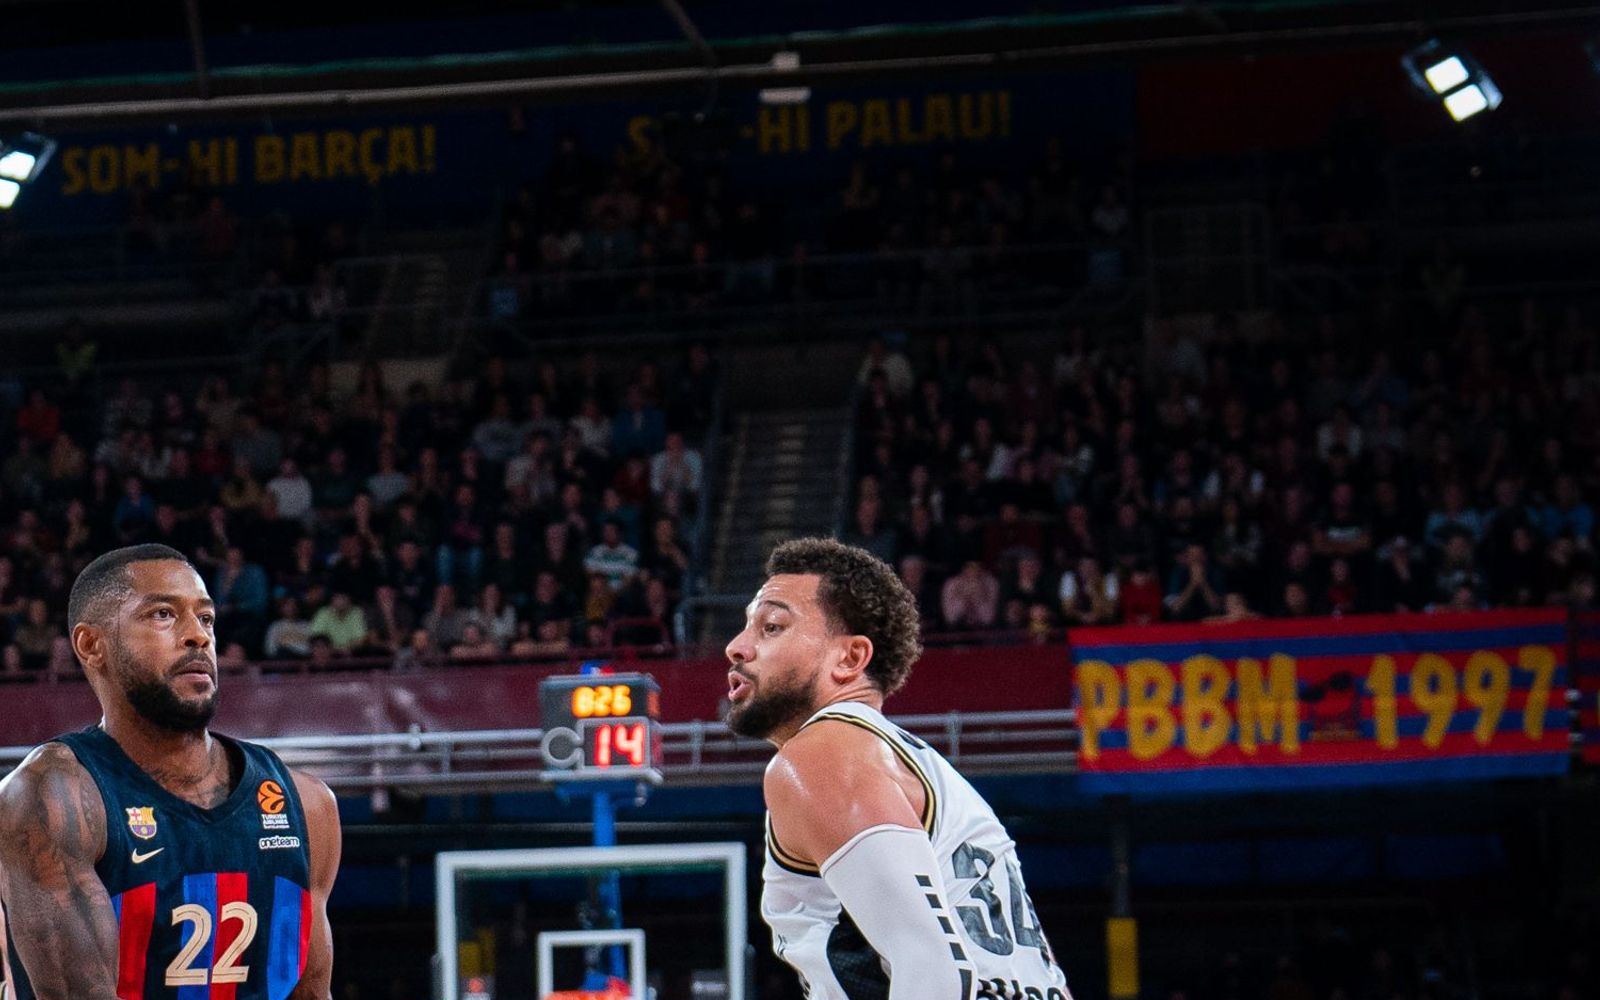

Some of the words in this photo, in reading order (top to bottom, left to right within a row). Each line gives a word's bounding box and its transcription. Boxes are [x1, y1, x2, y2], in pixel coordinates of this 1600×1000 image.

[825, 88, 1012, 150] PALAU!
[61, 135, 240, 196] SOM-HI
[252, 123, 437, 187] BARÇA!
[1076, 654, 1297, 761] PBBM
[1366, 645, 1557, 750] 1997
[594, 723, 646, 767] 14
[260, 836, 299, 848] oneteam
[951, 840, 1052, 969] 34
[164, 901, 258, 986] 22
